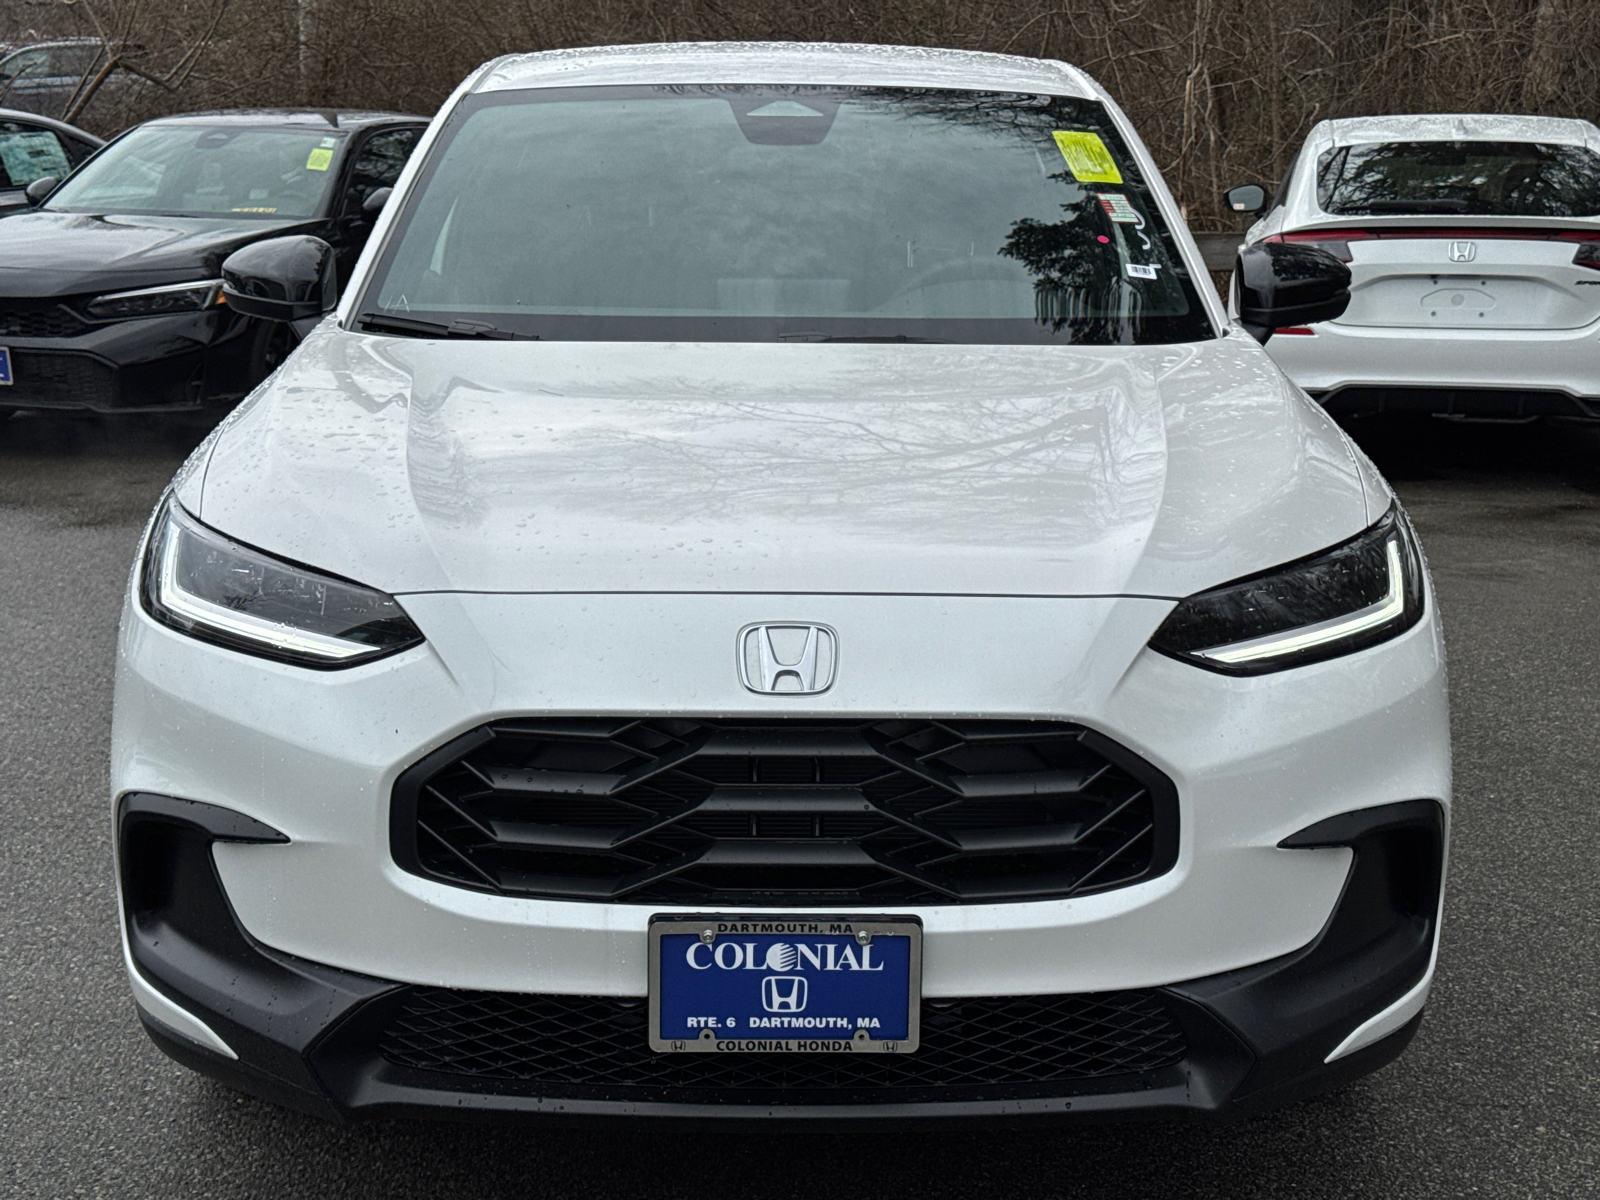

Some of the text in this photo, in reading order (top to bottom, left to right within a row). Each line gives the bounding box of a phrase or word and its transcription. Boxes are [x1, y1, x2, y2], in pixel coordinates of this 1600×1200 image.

[717, 923, 854, 934] DARTMOUTH, MA
[686, 1017, 881, 1030] RTE. 6 DARTMOUTH, MA
[716, 1040, 853, 1052] COLONIAL HONDA
